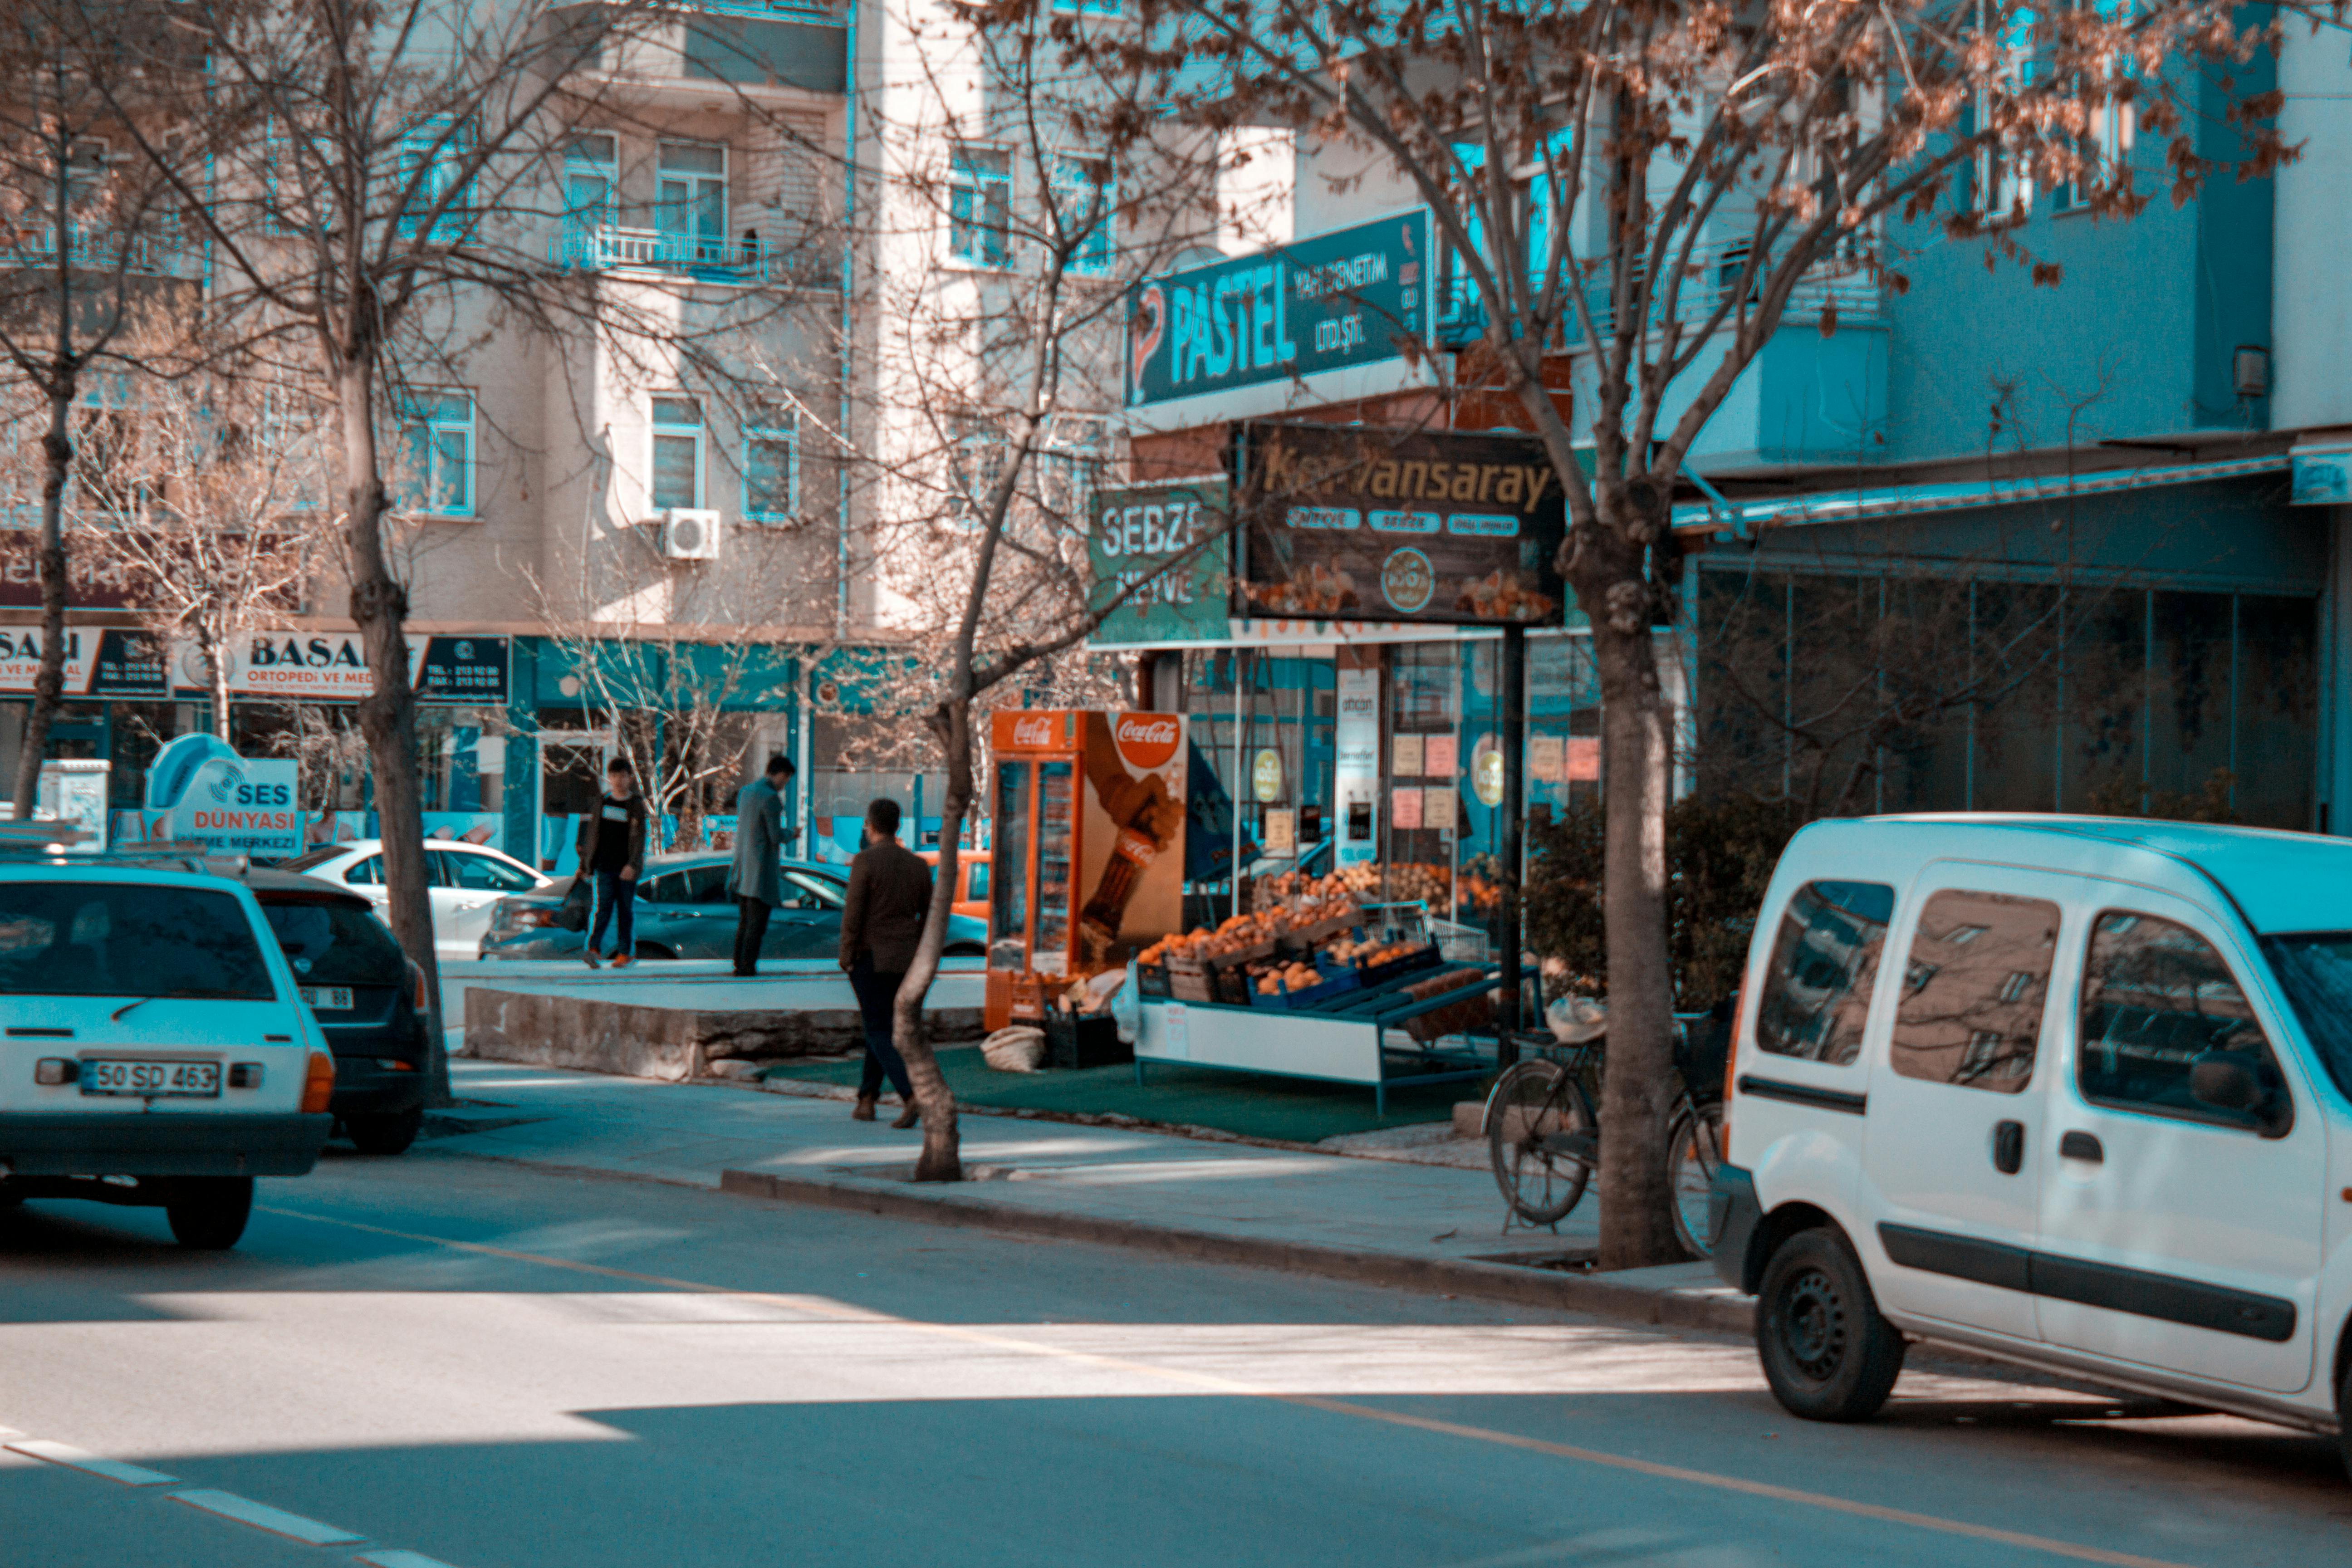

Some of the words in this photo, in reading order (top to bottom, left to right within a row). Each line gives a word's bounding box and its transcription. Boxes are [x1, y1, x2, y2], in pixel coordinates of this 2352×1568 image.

[1172, 260, 1296, 384] PASTEL
[323, 672, 340, 683] VE
[1118, 719, 1177, 744] Coca-Cola
[236, 784, 290, 805] SES
[194, 807, 295, 830] DÜNYASI
[98, 1065, 125, 1086] 50
[132, 1066, 164, 1088] SD
[172, 1066, 212, 1088] 463
